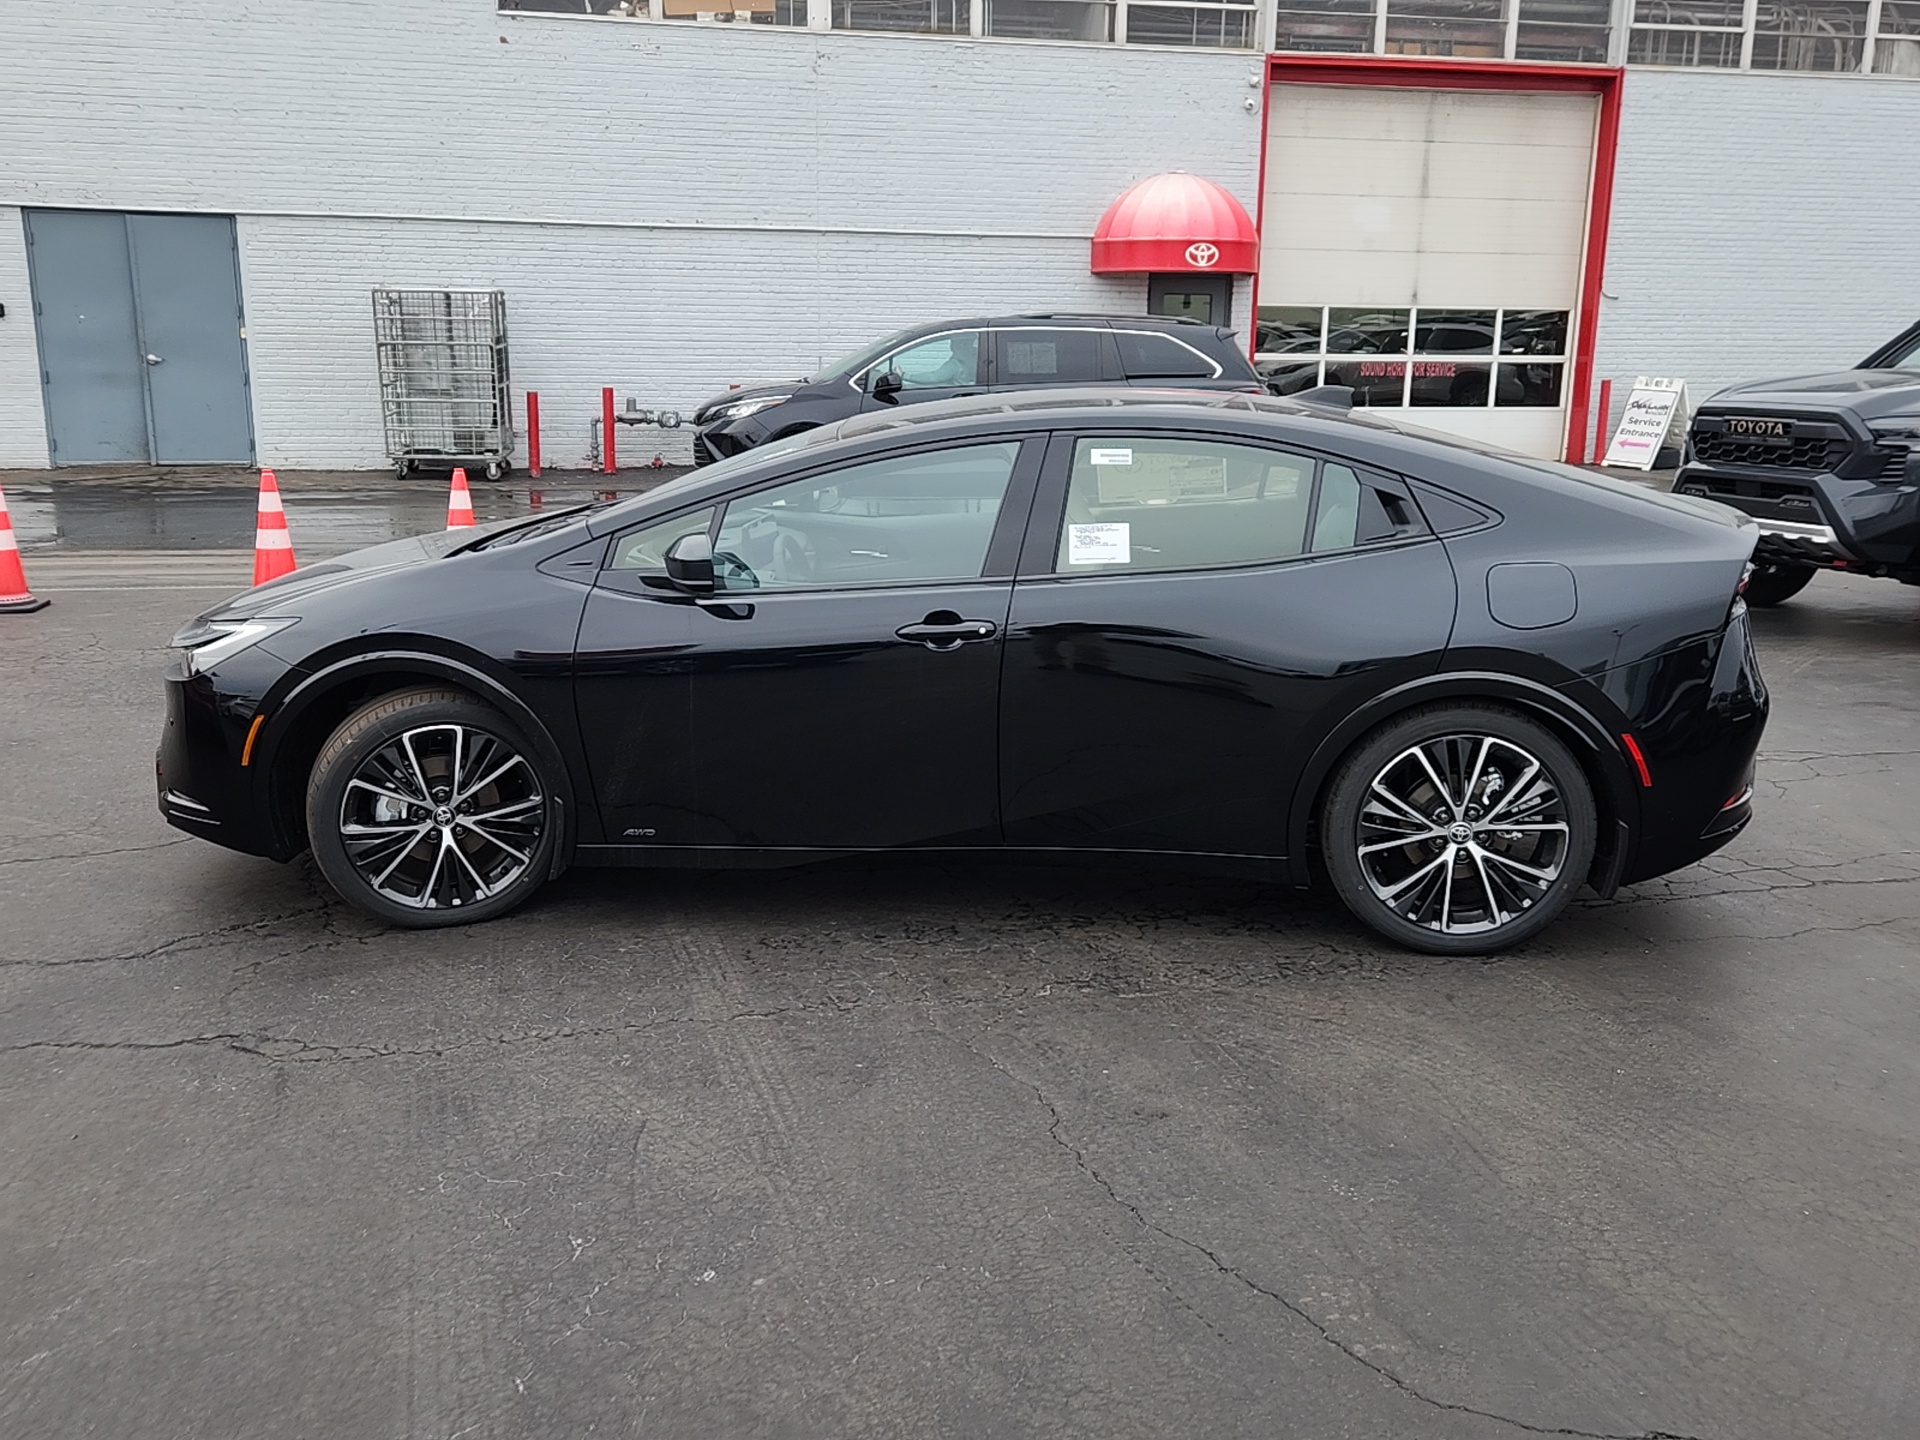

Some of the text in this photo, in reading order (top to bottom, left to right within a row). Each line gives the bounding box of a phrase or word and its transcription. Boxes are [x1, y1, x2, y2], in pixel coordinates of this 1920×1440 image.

[1360, 362, 1386, 377] SOUND
[1426, 363, 1456, 377] SERVICE
[1627, 416, 1662, 427] Service
[1619, 428, 1661, 439] Entrance
[1730, 420, 1784, 436] TOYOTA
[622, 828, 656, 836] AWD
